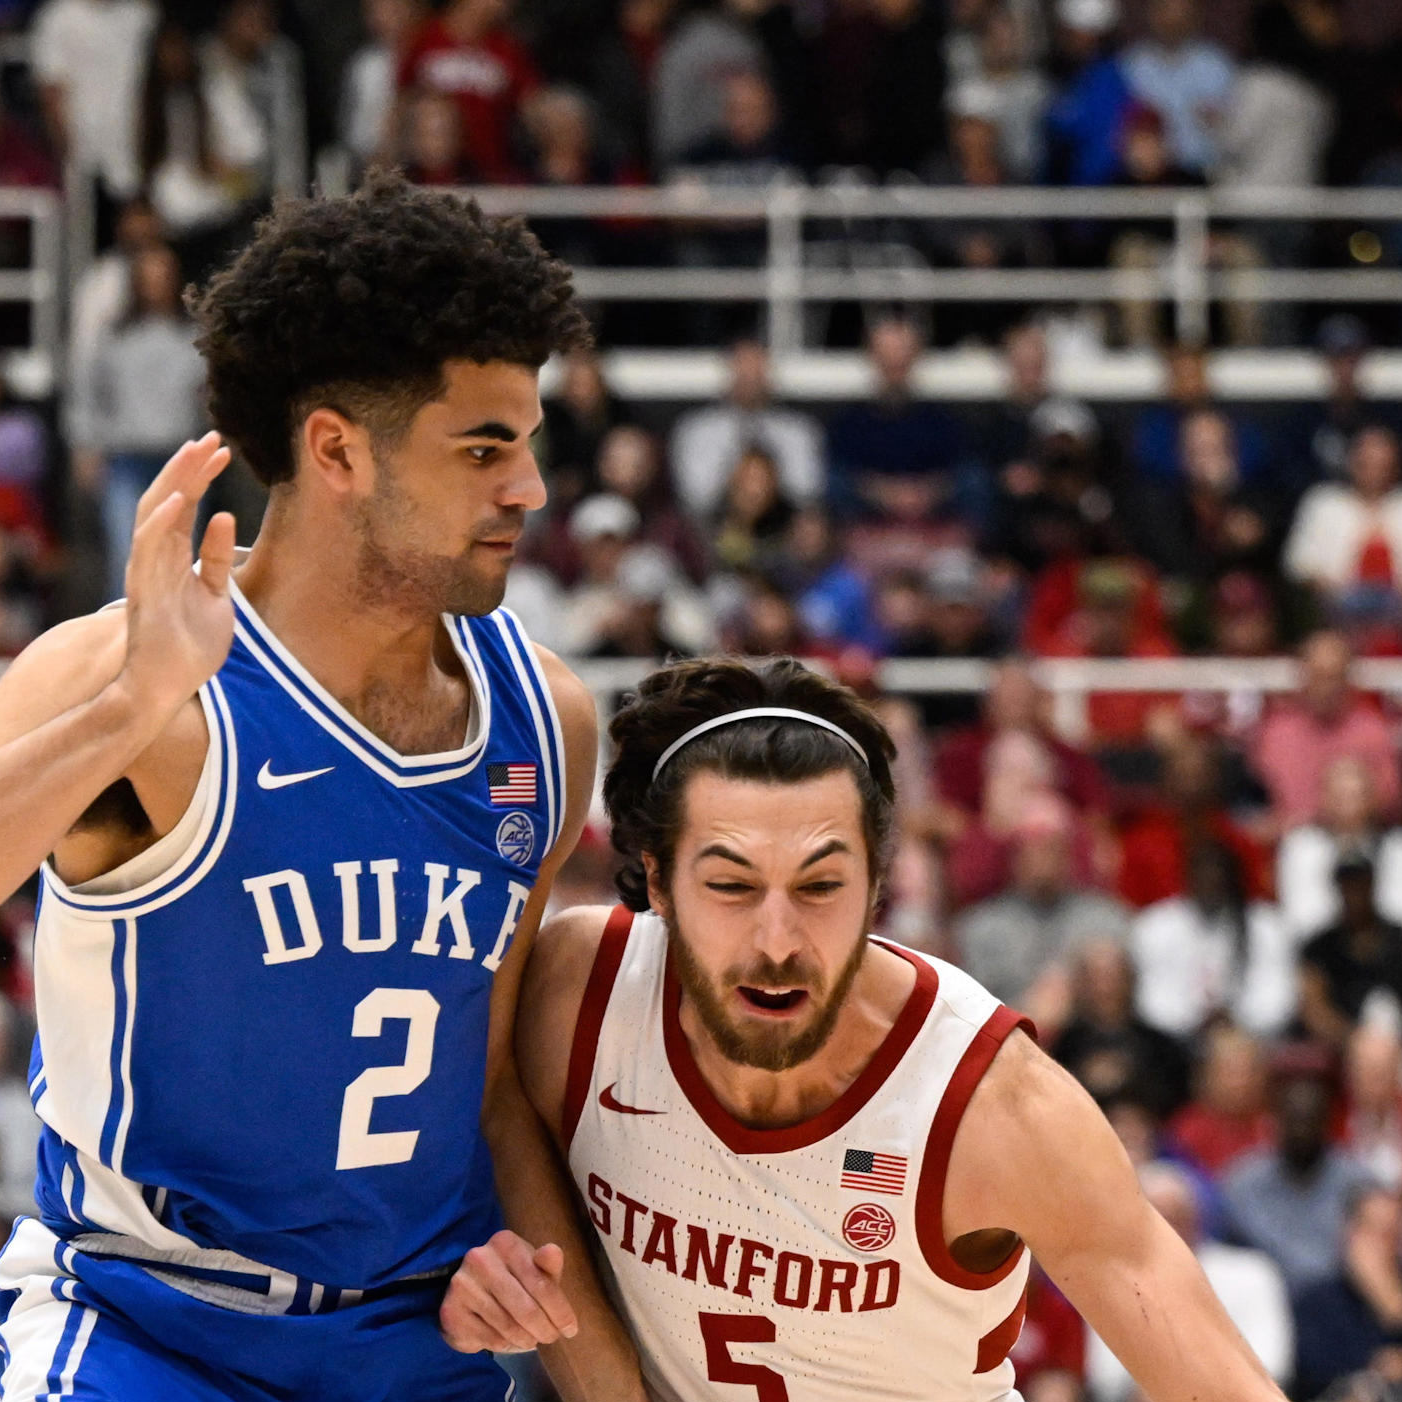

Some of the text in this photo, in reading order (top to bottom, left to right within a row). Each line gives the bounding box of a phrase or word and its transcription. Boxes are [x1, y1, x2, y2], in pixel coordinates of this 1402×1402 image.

[335, 987, 441, 1170] 2
[587, 1172, 900, 1313] STANFORD
[850, 1219, 892, 1233] ACC
